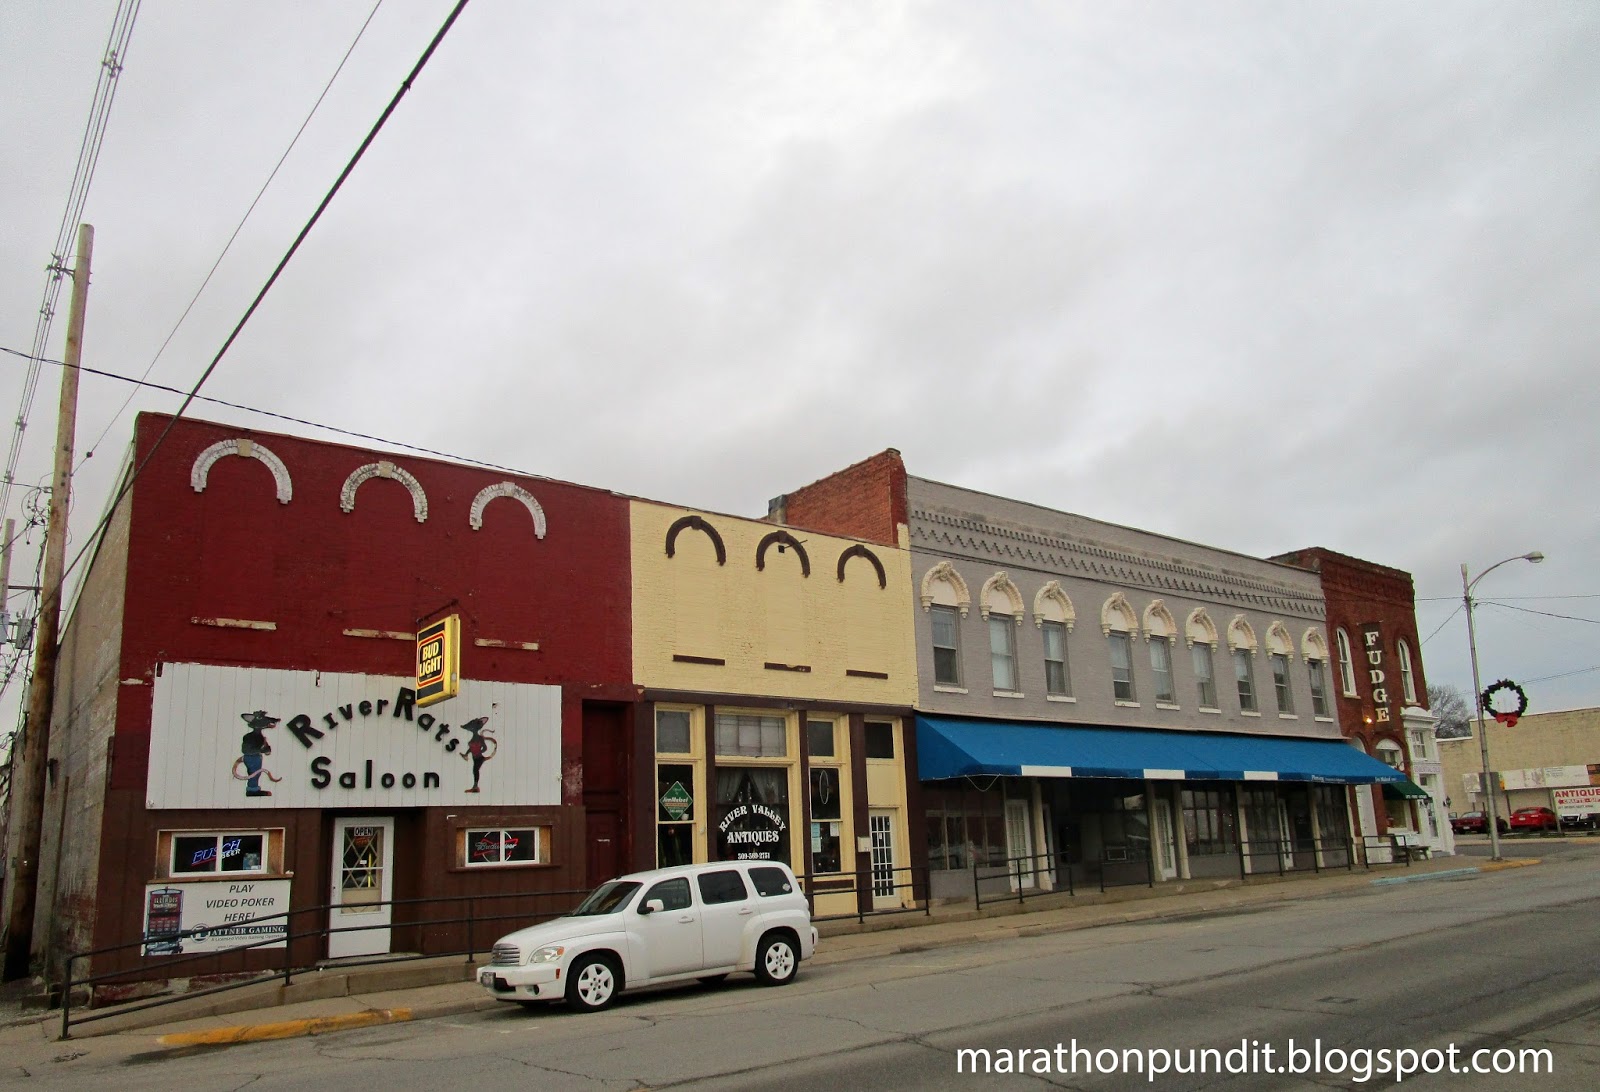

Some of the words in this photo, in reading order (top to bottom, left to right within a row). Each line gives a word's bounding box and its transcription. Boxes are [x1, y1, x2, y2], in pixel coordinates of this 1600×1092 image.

[422, 642, 440, 661] BUD
[419, 655, 442, 677] LIGHT
[1364, 631, 1390, 722] FUDGE
[286, 699, 389, 749] River
[393, 686, 459, 752] Rats
[311, 756, 440, 789] Saloon
[719, 805, 748, 832] RIVER
[752, 805, 786, 831] VALLEY
[355, 827, 373, 836] OPEN
[727, 830, 779, 846] ANTIQUES
[229, 884, 254, 893] PLAY
[206, 899, 239, 909] VIDEO
[241, 897, 275, 907] POKER
[224, 912, 256, 922] HERE!
[249, 925, 285, 934] GAMING
